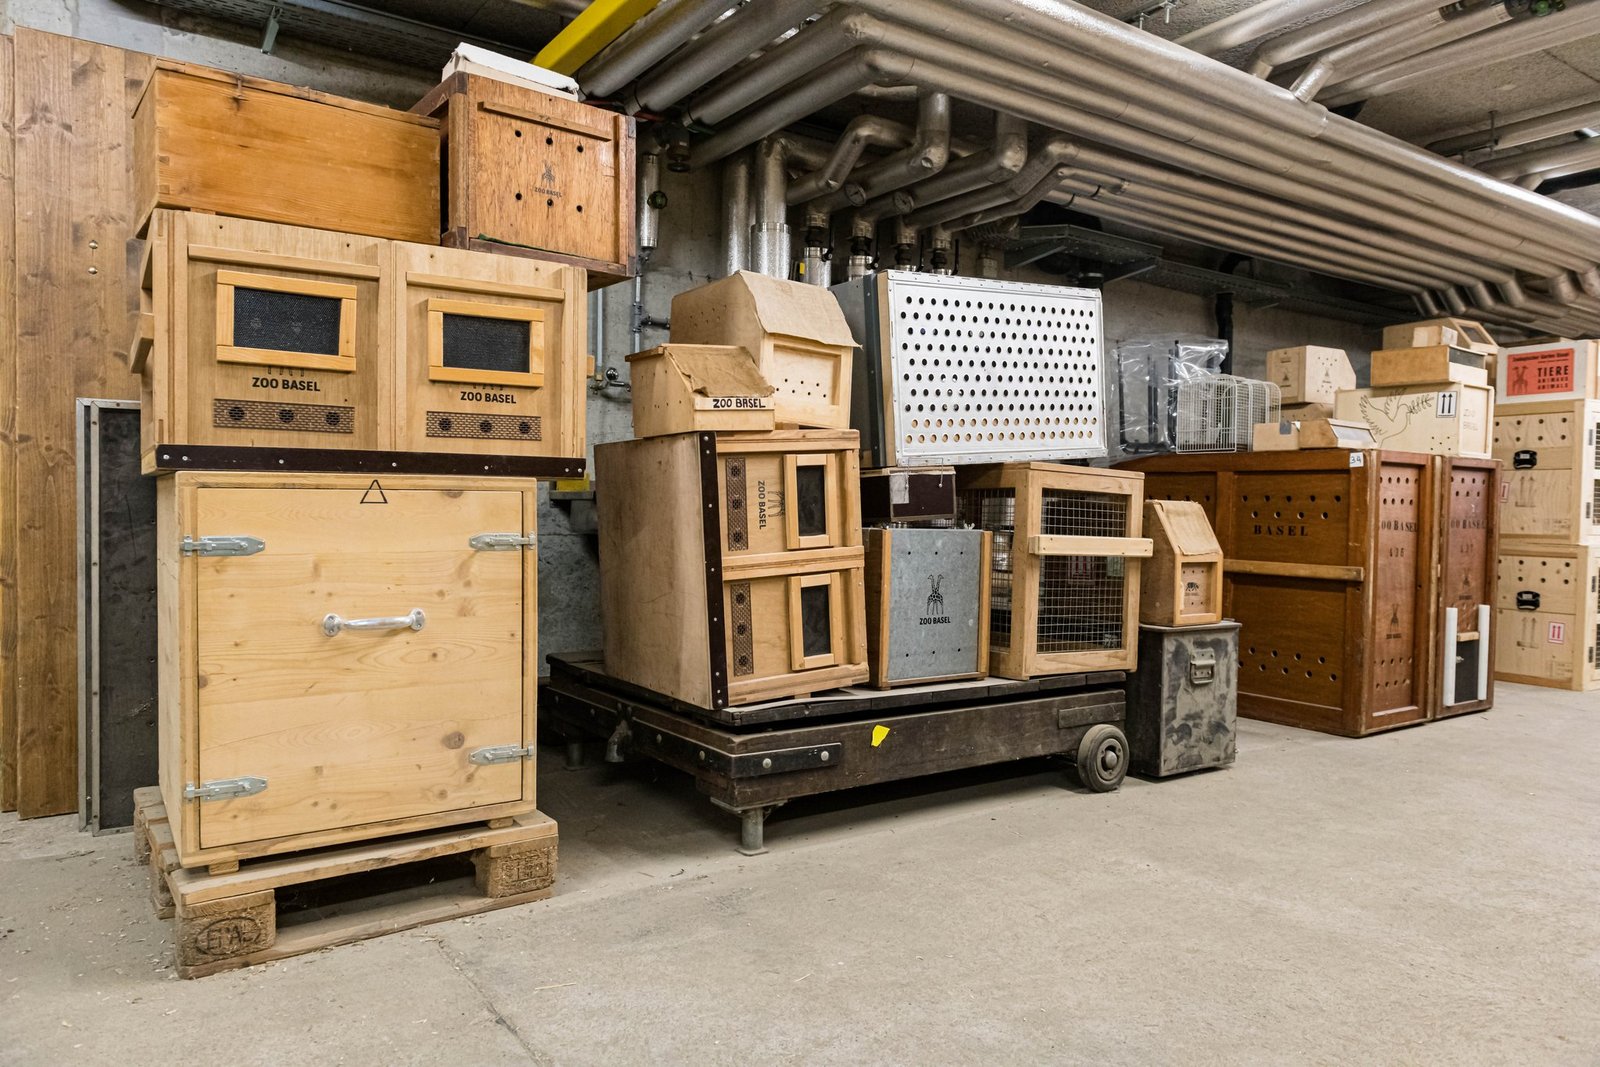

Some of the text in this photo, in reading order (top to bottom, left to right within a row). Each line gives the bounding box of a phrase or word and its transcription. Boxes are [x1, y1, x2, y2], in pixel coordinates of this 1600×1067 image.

[1537, 365, 1569, 377] TIERE
[251, 377, 321, 392] ZOO BASEL
[460, 391, 517, 404] ZOO BASEL
[712, 398, 766, 409] ZOO BASEL
[757, 480, 767, 530] ZOO BASEL
[1253, 525, 1309, 537] BASEL
[919, 616, 951, 626] ZOO BASEL
